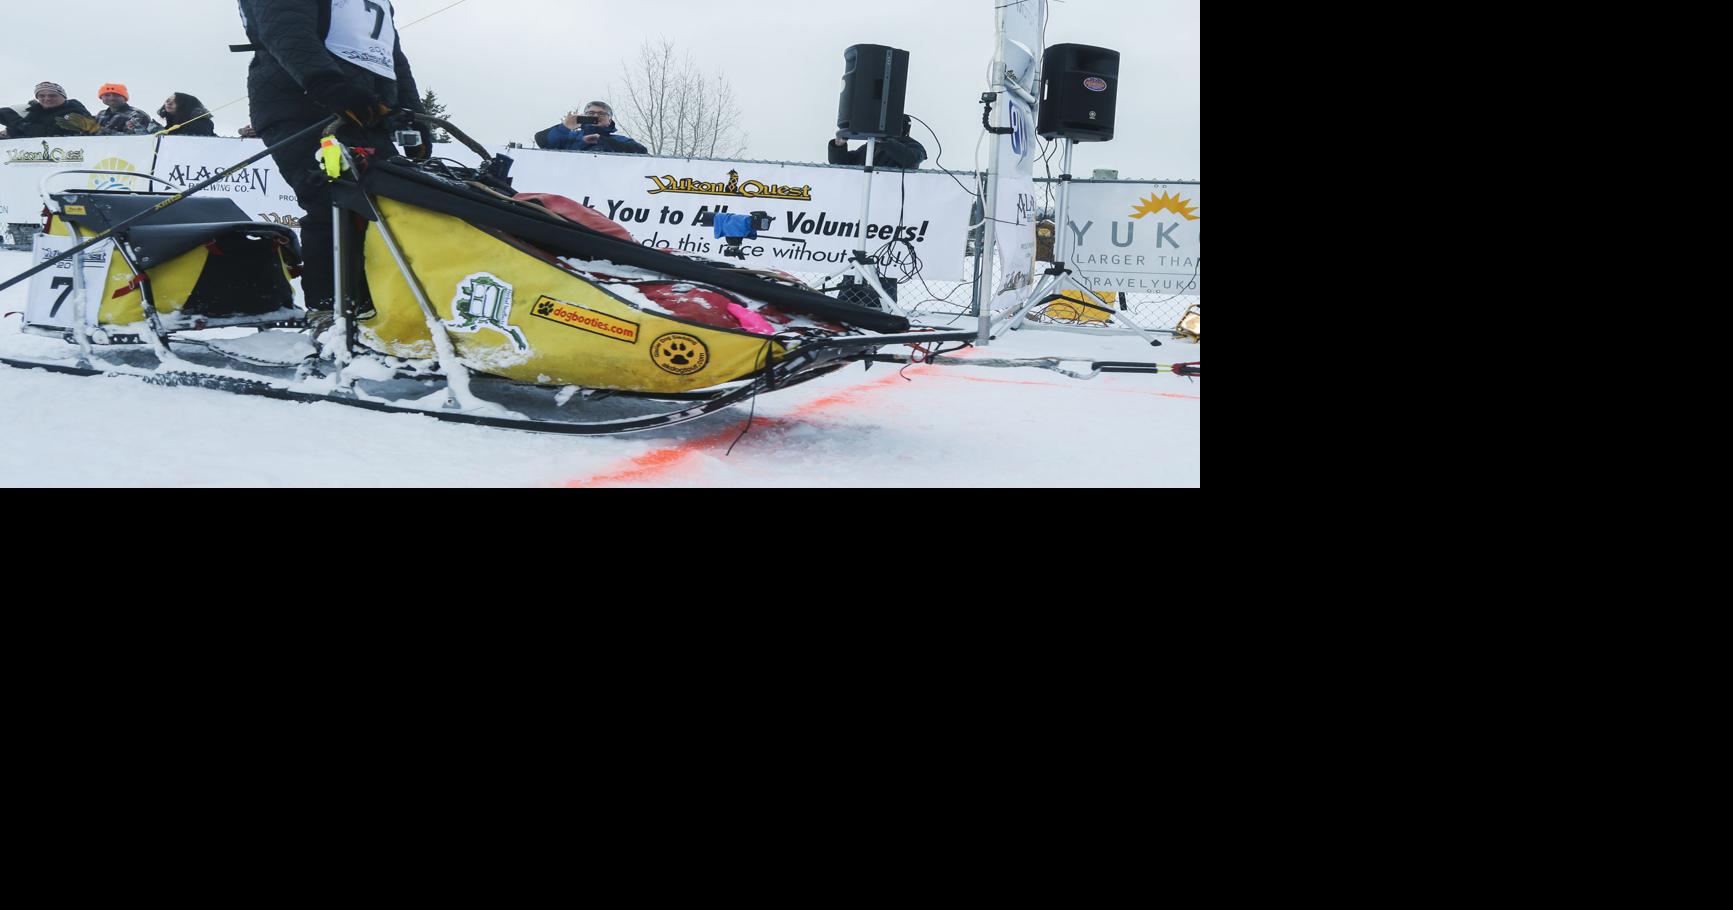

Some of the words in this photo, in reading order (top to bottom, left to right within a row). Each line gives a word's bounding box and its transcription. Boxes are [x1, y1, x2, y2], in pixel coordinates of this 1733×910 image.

[363, 0, 385, 40] 7
[51, 147, 84, 162] Qest
[189, 182, 230, 192] BEWING
[234, 185, 249, 193] CO.
[645, 174, 724, 194] Yukon
[737, 180, 812, 201] Quest
[607, 200, 650, 224] You
[659, 205, 684, 226] to
[1069, 220, 1200, 249] YUK
[678, 236, 710, 254] this
[718, 243, 764, 257] rce
[772, 244, 847, 263] without
[1076, 254, 1145, 266] LARGER
[50, 276, 73, 318] 7
[554, 307, 634, 337] dogbooties.com
